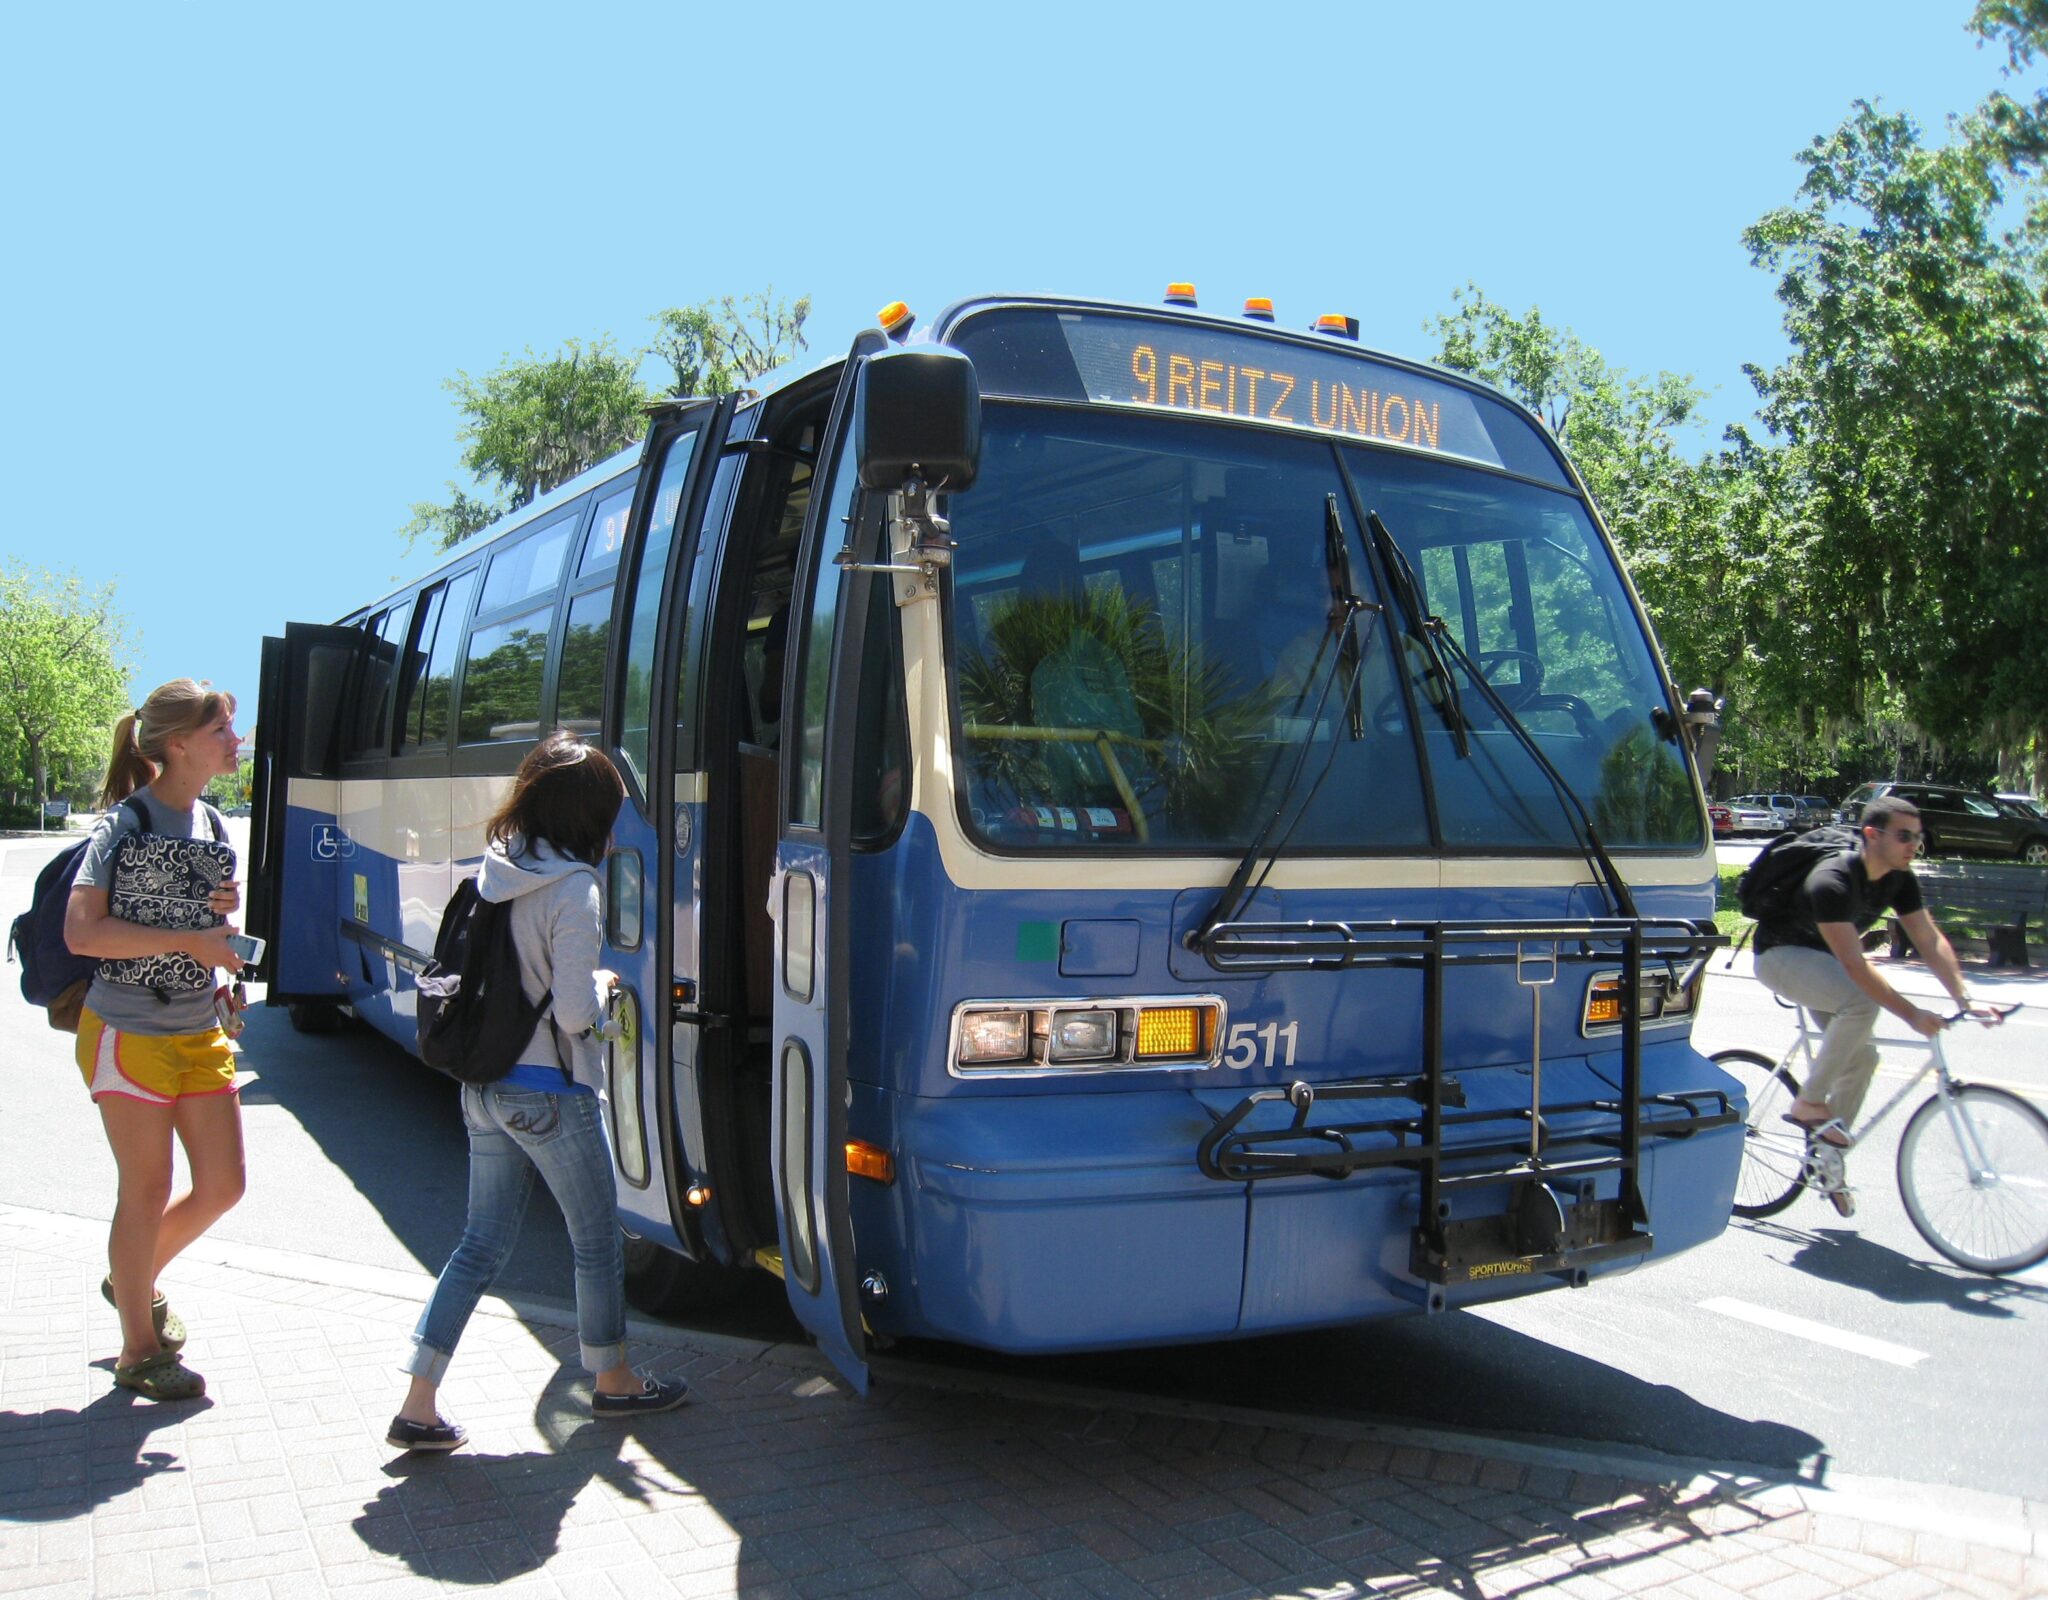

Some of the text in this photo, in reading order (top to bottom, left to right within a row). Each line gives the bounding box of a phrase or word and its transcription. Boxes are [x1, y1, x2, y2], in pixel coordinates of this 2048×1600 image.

[1132, 344, 1440, 449] 9 REITZ UNION
[1224, 1021, 1298, 1070] 511
